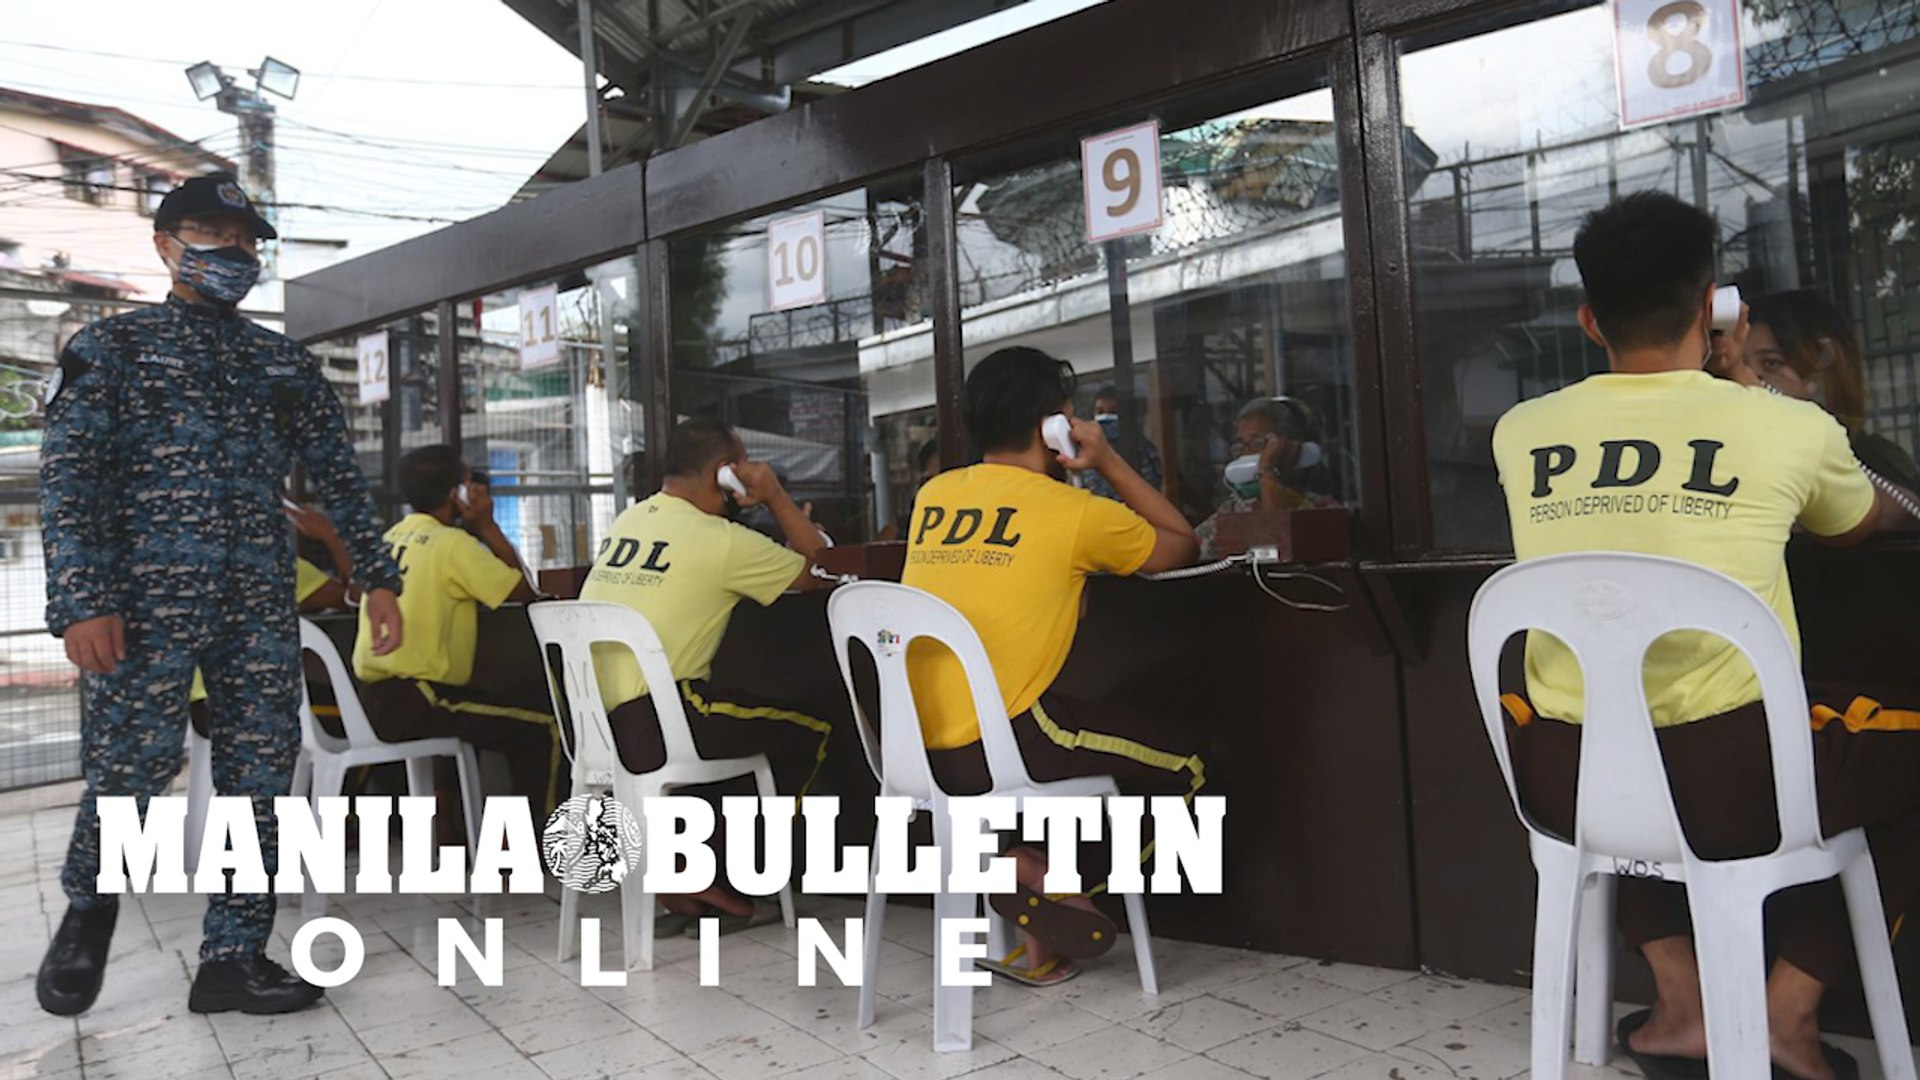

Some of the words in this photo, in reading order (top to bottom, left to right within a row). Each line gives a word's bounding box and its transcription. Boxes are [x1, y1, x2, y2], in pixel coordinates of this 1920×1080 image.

[1646, 1, 1712, 89] 8
[1102, 148, 1141, 218] 9
[774, 235, 819, 287] 10
[523, 305, 555, 347] 11
[361, 350, 386, 386] 12
[1529, 439, 1740, 498] PDL
[915, 506, 1021, 547] PDL
[1529, 500, 1573, 524] PERSON
[1574, 494, 1644, 517] DEPRIVED
[1647, 494, 1669, 513] OF
[1672, 495, 1734, 520] LIBERTY
[974, 550, 1016, 568] LIBERTY
